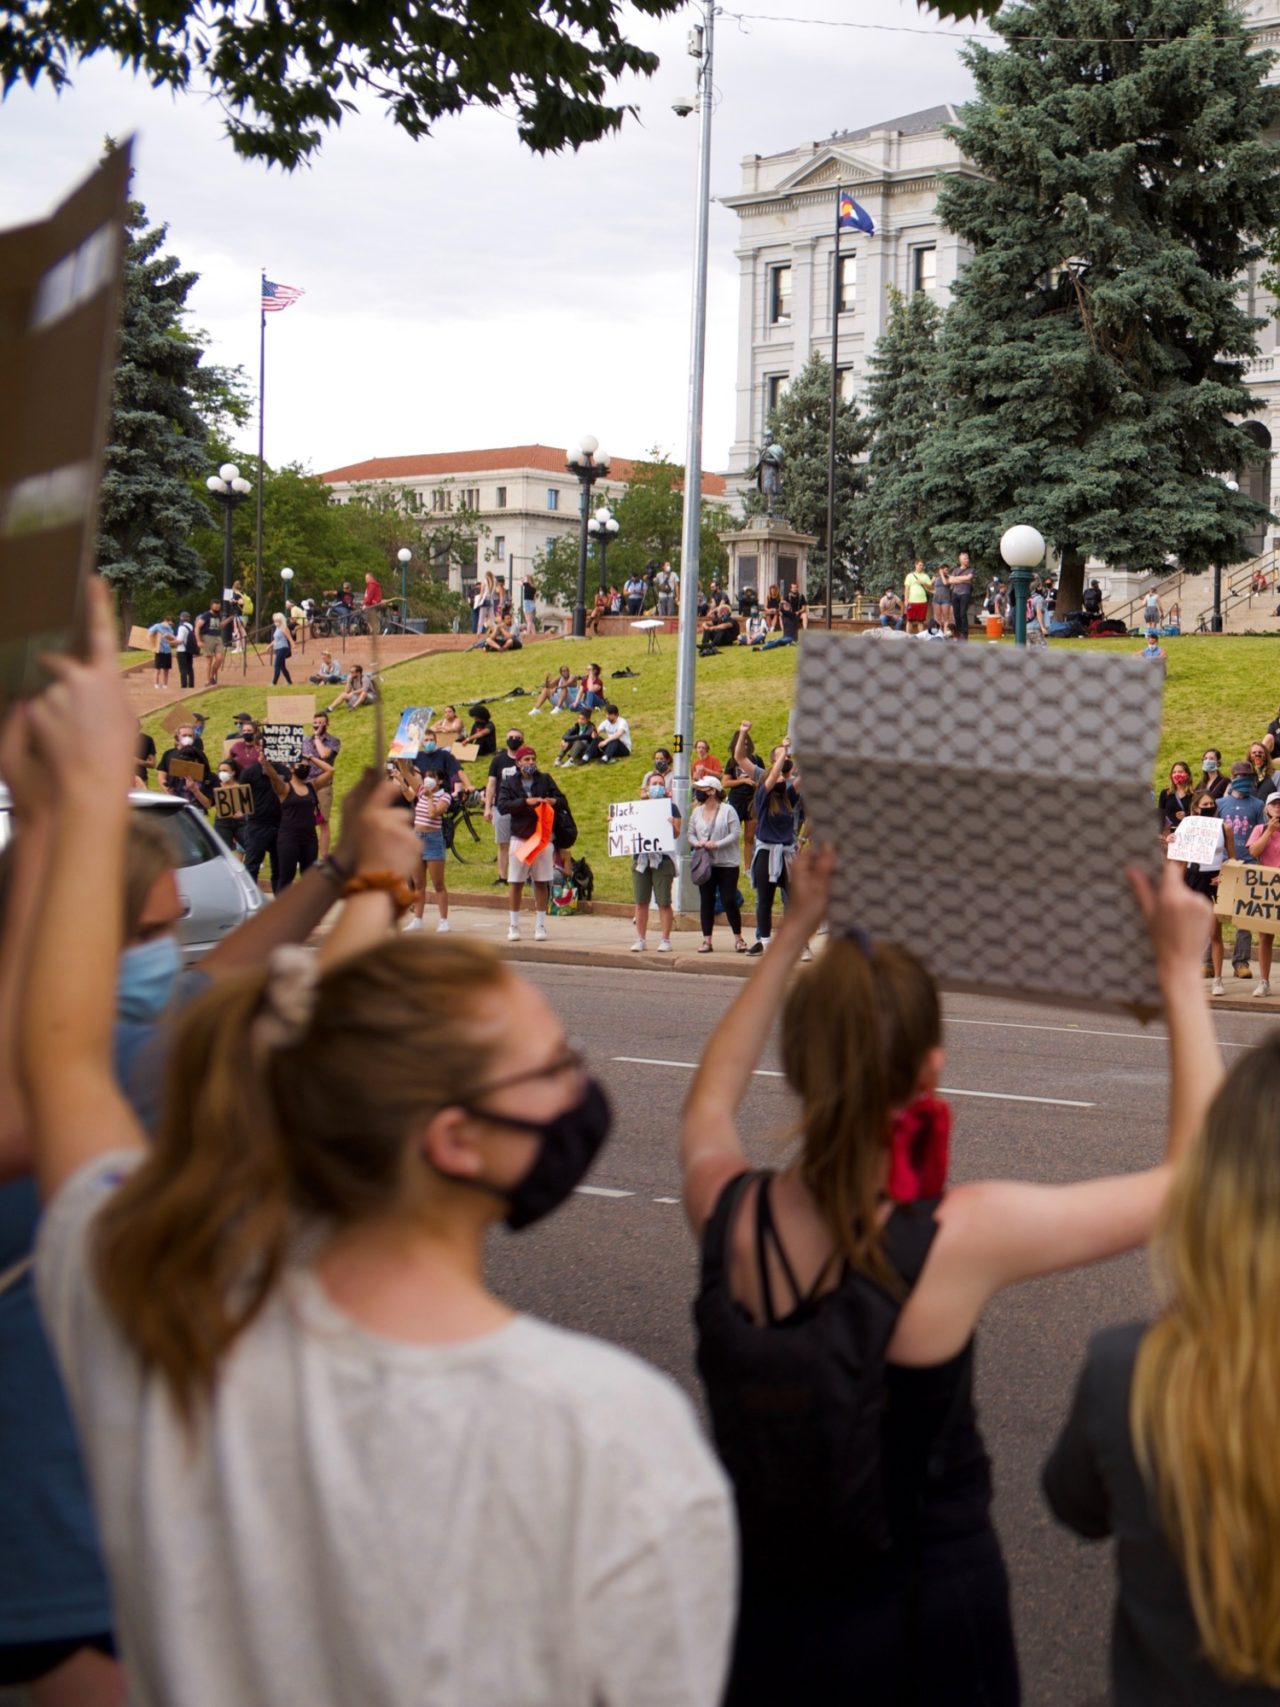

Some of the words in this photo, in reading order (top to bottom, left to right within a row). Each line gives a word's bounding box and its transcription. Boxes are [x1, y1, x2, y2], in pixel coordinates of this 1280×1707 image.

[264, 725, 290, 735] WHO
[293, 727, 303, 735] DO
[263, 736, 277, 744] YOU
[278, 736, 303, 744] CALL
[609, 803, 639, 818] Black.
[609, 823, 637, 833] Lives.
[609, 832, 662, 857] Matter.
